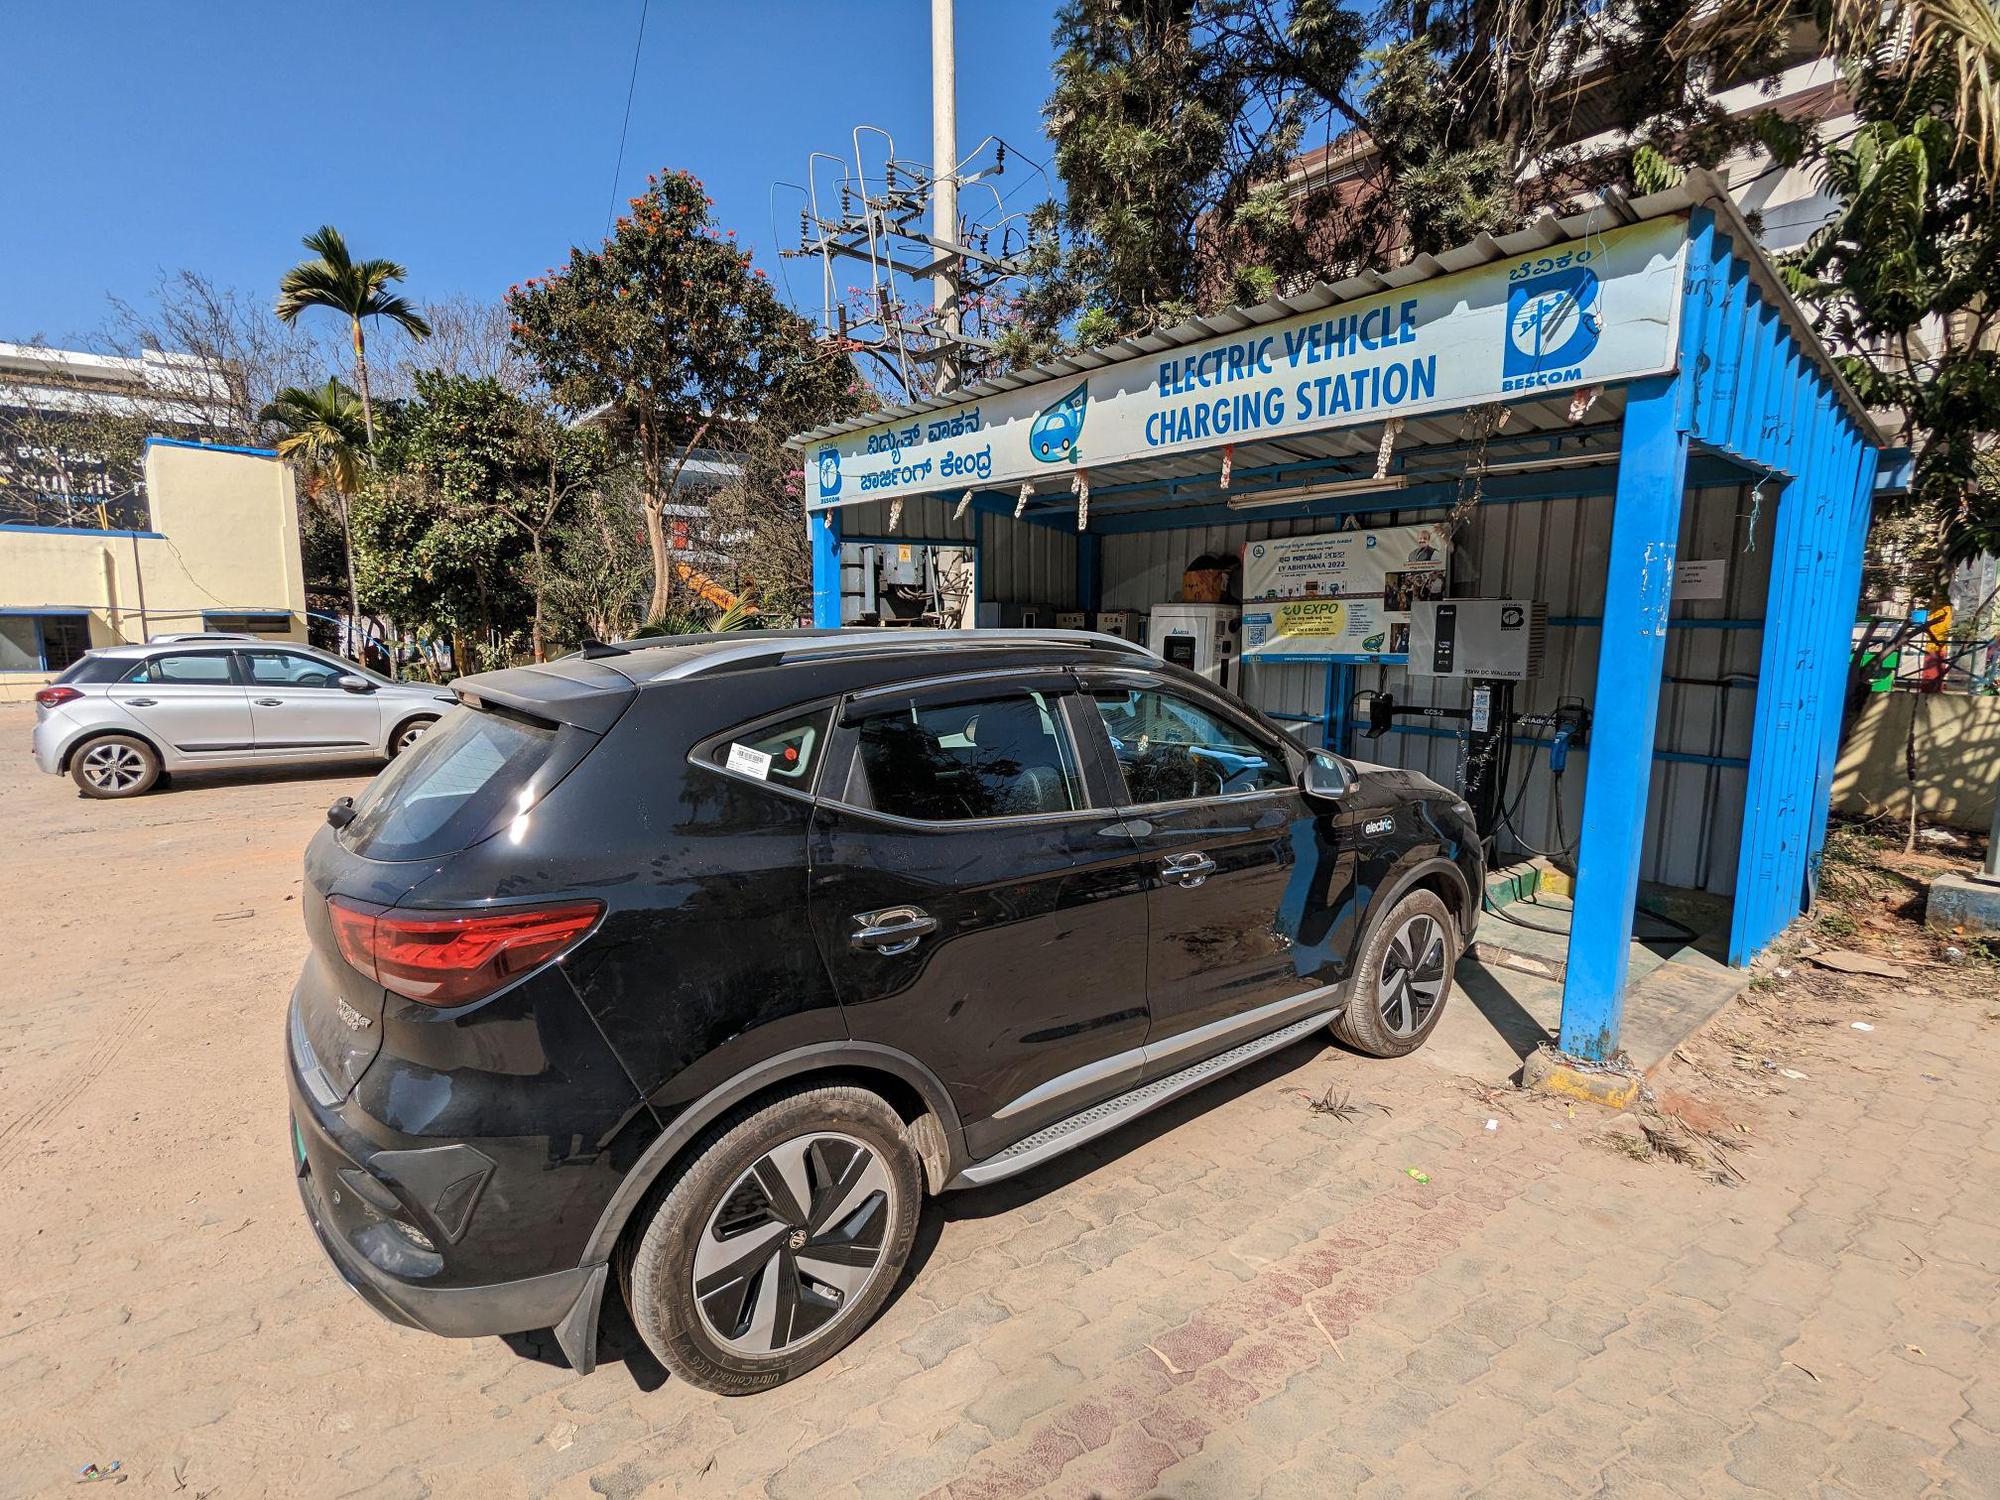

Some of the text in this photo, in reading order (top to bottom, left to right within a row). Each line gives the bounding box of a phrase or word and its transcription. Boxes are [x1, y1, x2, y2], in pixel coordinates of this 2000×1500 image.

[1160, 299, 1418, 398] ELECTRIC VEHICLE
[1502, 367, 1582, 393] BESCOM
[1145, 354, 1436, 446] CHARGING STATION
[928, 406, 980, 443] ವಾಹನ
[1327, 560, 1345, 568] 2022
[1303, 603, 1339, 615] EXPO
[1490, 669, 1522, 677] WALLBOX
[1365, 818, 1392, 834] electric
